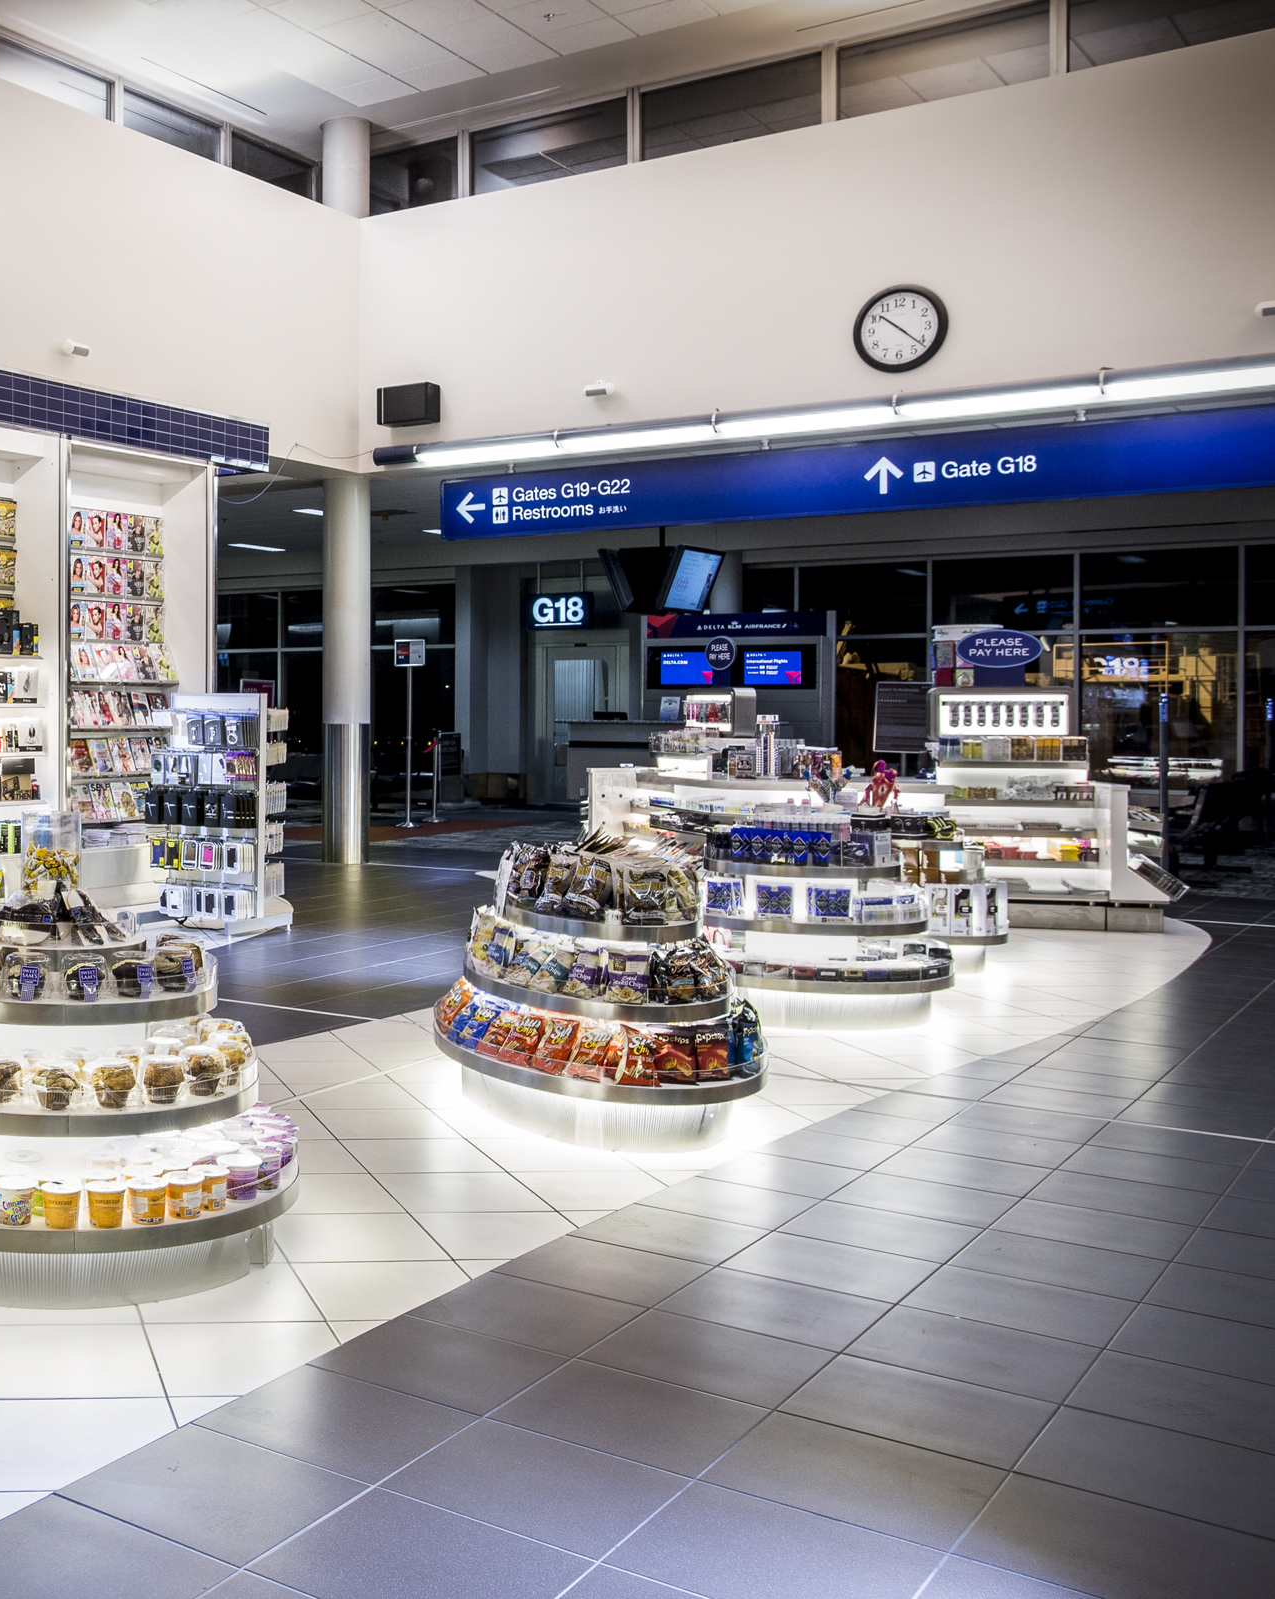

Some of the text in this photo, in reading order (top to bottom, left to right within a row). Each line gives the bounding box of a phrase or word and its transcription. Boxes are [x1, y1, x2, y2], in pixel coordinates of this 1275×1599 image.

[894, 297, 906, 308] 12
[911, 299, 917, 309] 1
[880, 303, 890, 313] 11
[921, 307, 928, 317] 2
[870, 313, 881, 324] 10
[924, 320, 932, 330] 3
[868, 327, 875, 337] 9
[918, 334, 927, 344] 4
[871, 340, 879, 350] 8
[910, 345, 918, 355] 5
[881, 348, 889, 358] 7
[895, 350, 903, 360] 6
[941, 455, 1037, 479] Gate G18
[512, 478, 630, 502] Gates G19-G22
[512, 503, 594, 521] Restrooms
[598, 505, 627, 515] お手洗い
[532, 596, 584, 623] G18
[711, 643, 728, 652] PLEASE
[975, 638, 1023, 647] PLEASE
[709, 652, 731, 661] PAY HERE
[968, 647, 1030, 657] PAY HERE
[2, 1198, 30, 1211] Cinnamon
[10, 1209, 31, 1224] Crunch
